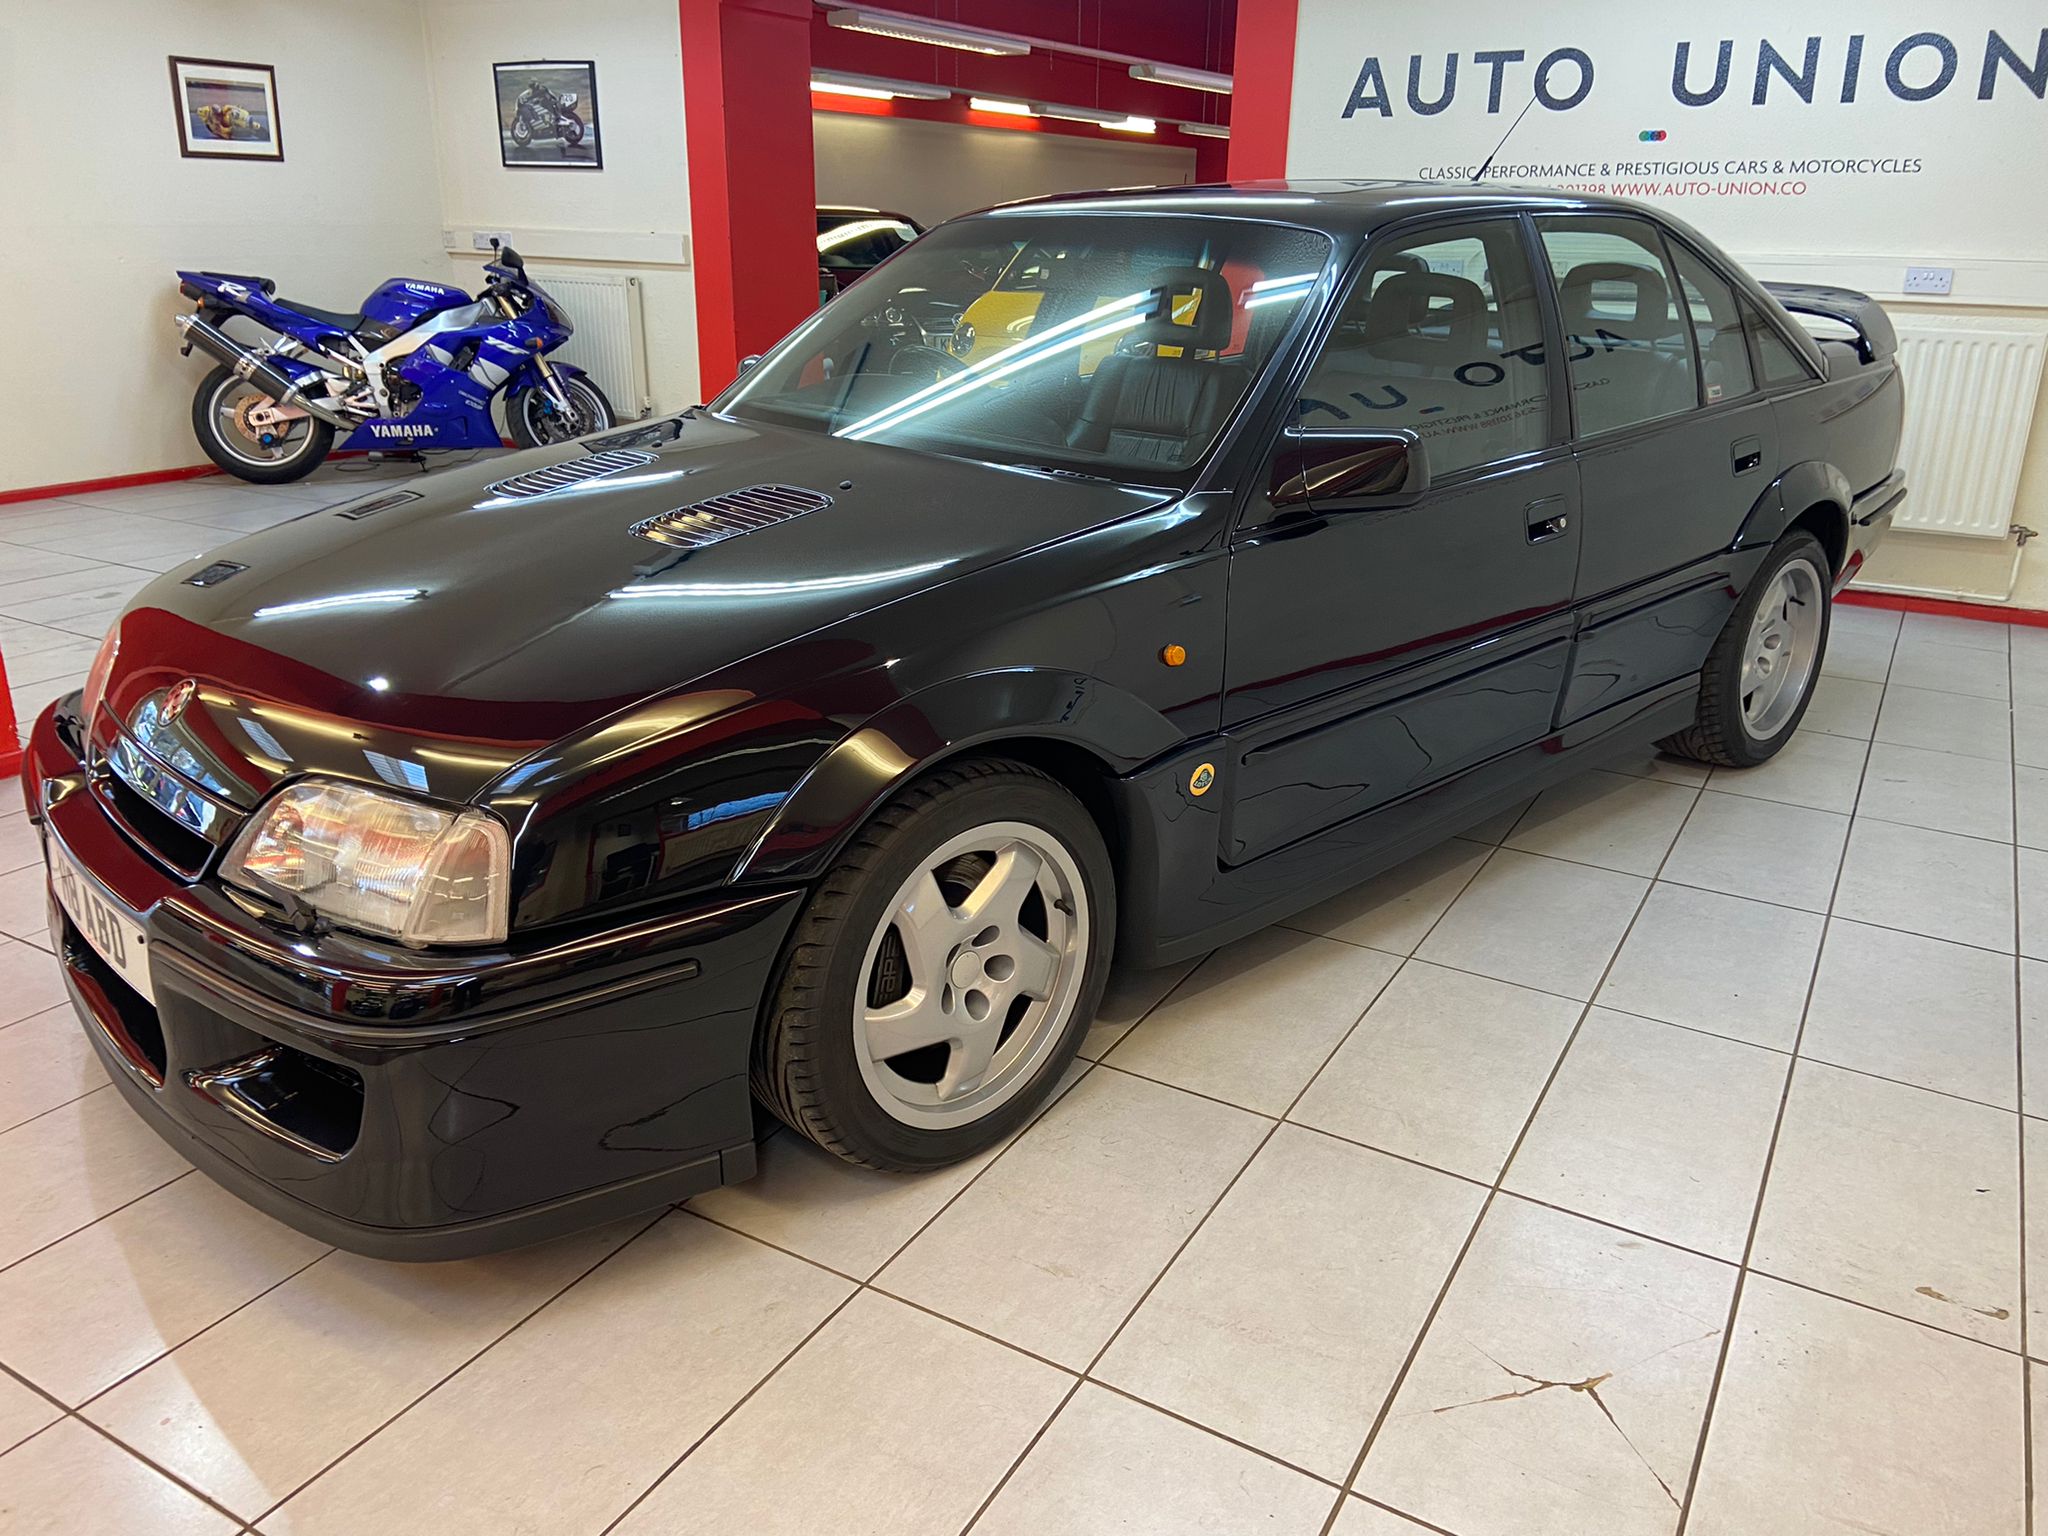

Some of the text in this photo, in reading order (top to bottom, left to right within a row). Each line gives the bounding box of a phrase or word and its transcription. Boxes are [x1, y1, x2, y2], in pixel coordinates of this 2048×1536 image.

[1341, 27, 2048, 119] AUTO UNION
[1418, 158, 1923, 181] CLASSIC PERFORMANCE & PRESTIGIOUS CARS & MOTORCYCLES
[1611, 180, 1807, 197] WWW.AUTO-UNION.CO
[405, 282, 445, 296] YAMAHA
[370, 424, 434, 438] YAMAHA
